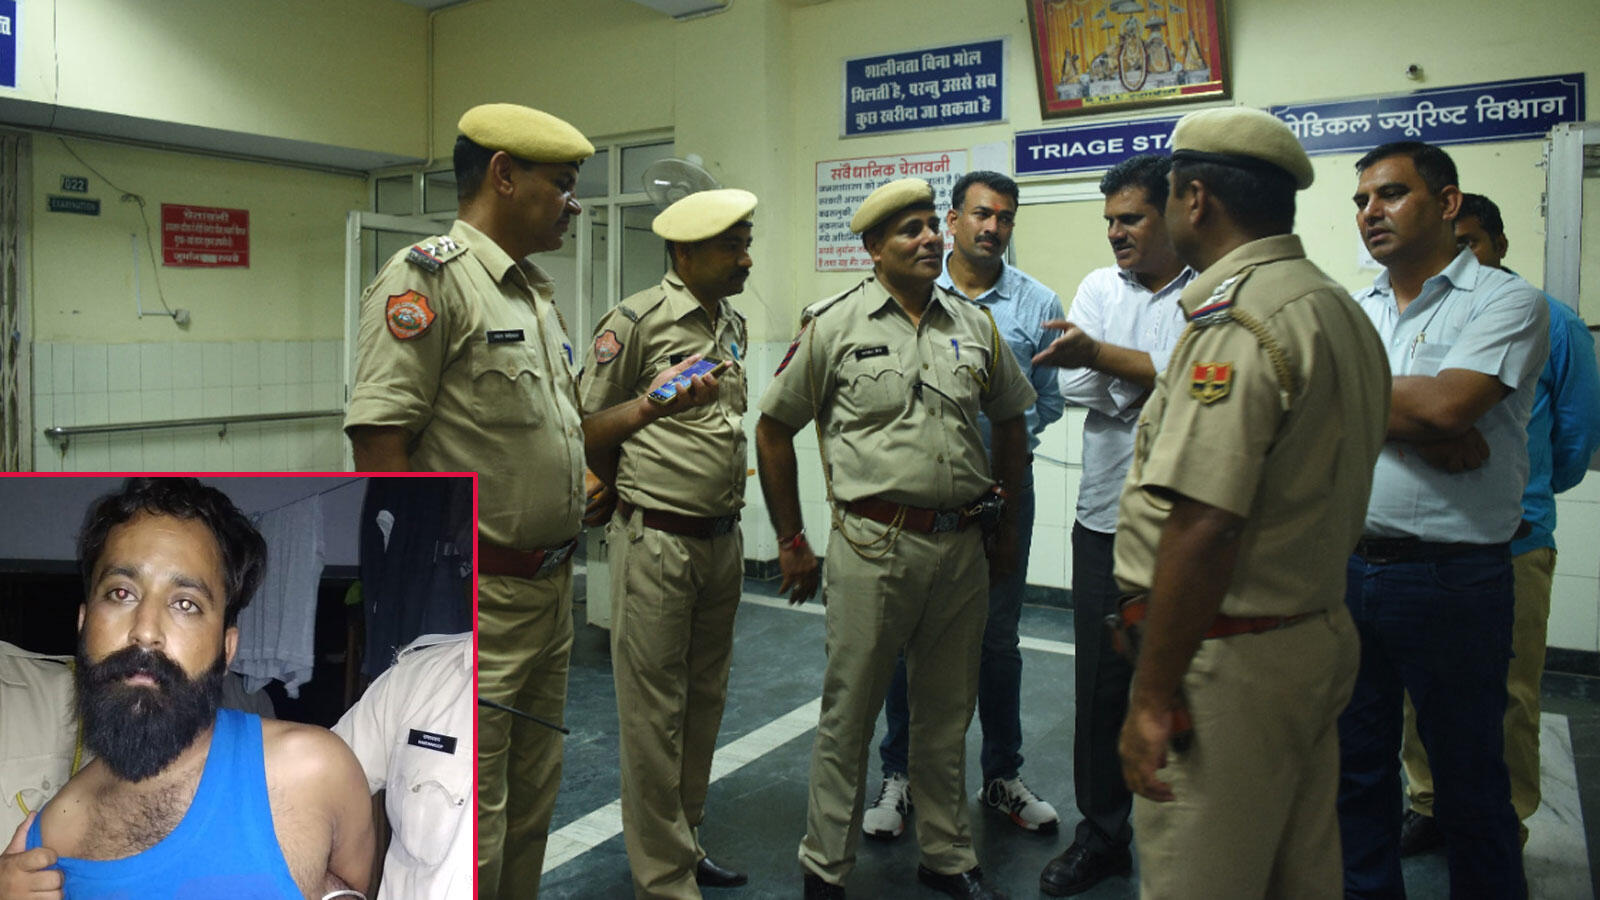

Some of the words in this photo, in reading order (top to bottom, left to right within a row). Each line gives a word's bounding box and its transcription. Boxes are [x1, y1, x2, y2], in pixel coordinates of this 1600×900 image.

[865, 58, 919, 78] शालीनता
[921, 53, 950, 71] बिना
[953, 48, 982, 66] मोल
[851, 83, 889, 103] मिलती
[909, 80, 941, 99] परन्तु
[942, 73, 972, 92] उससे
[975, 73, 997, 89] सब
[855, 110, 878, 130] कुछ
[880, 105, 918, 123] खरीदा
[920, 104, 937, 118] जा
[940, 100, 979, 116] सकता
[978, 95, 991, 113] है
[1475, 95, 1567, 123] विभाग
[1028, 138, 1124, 160] TRIAGE
[899, 154, 950, 175] चेतावनी
